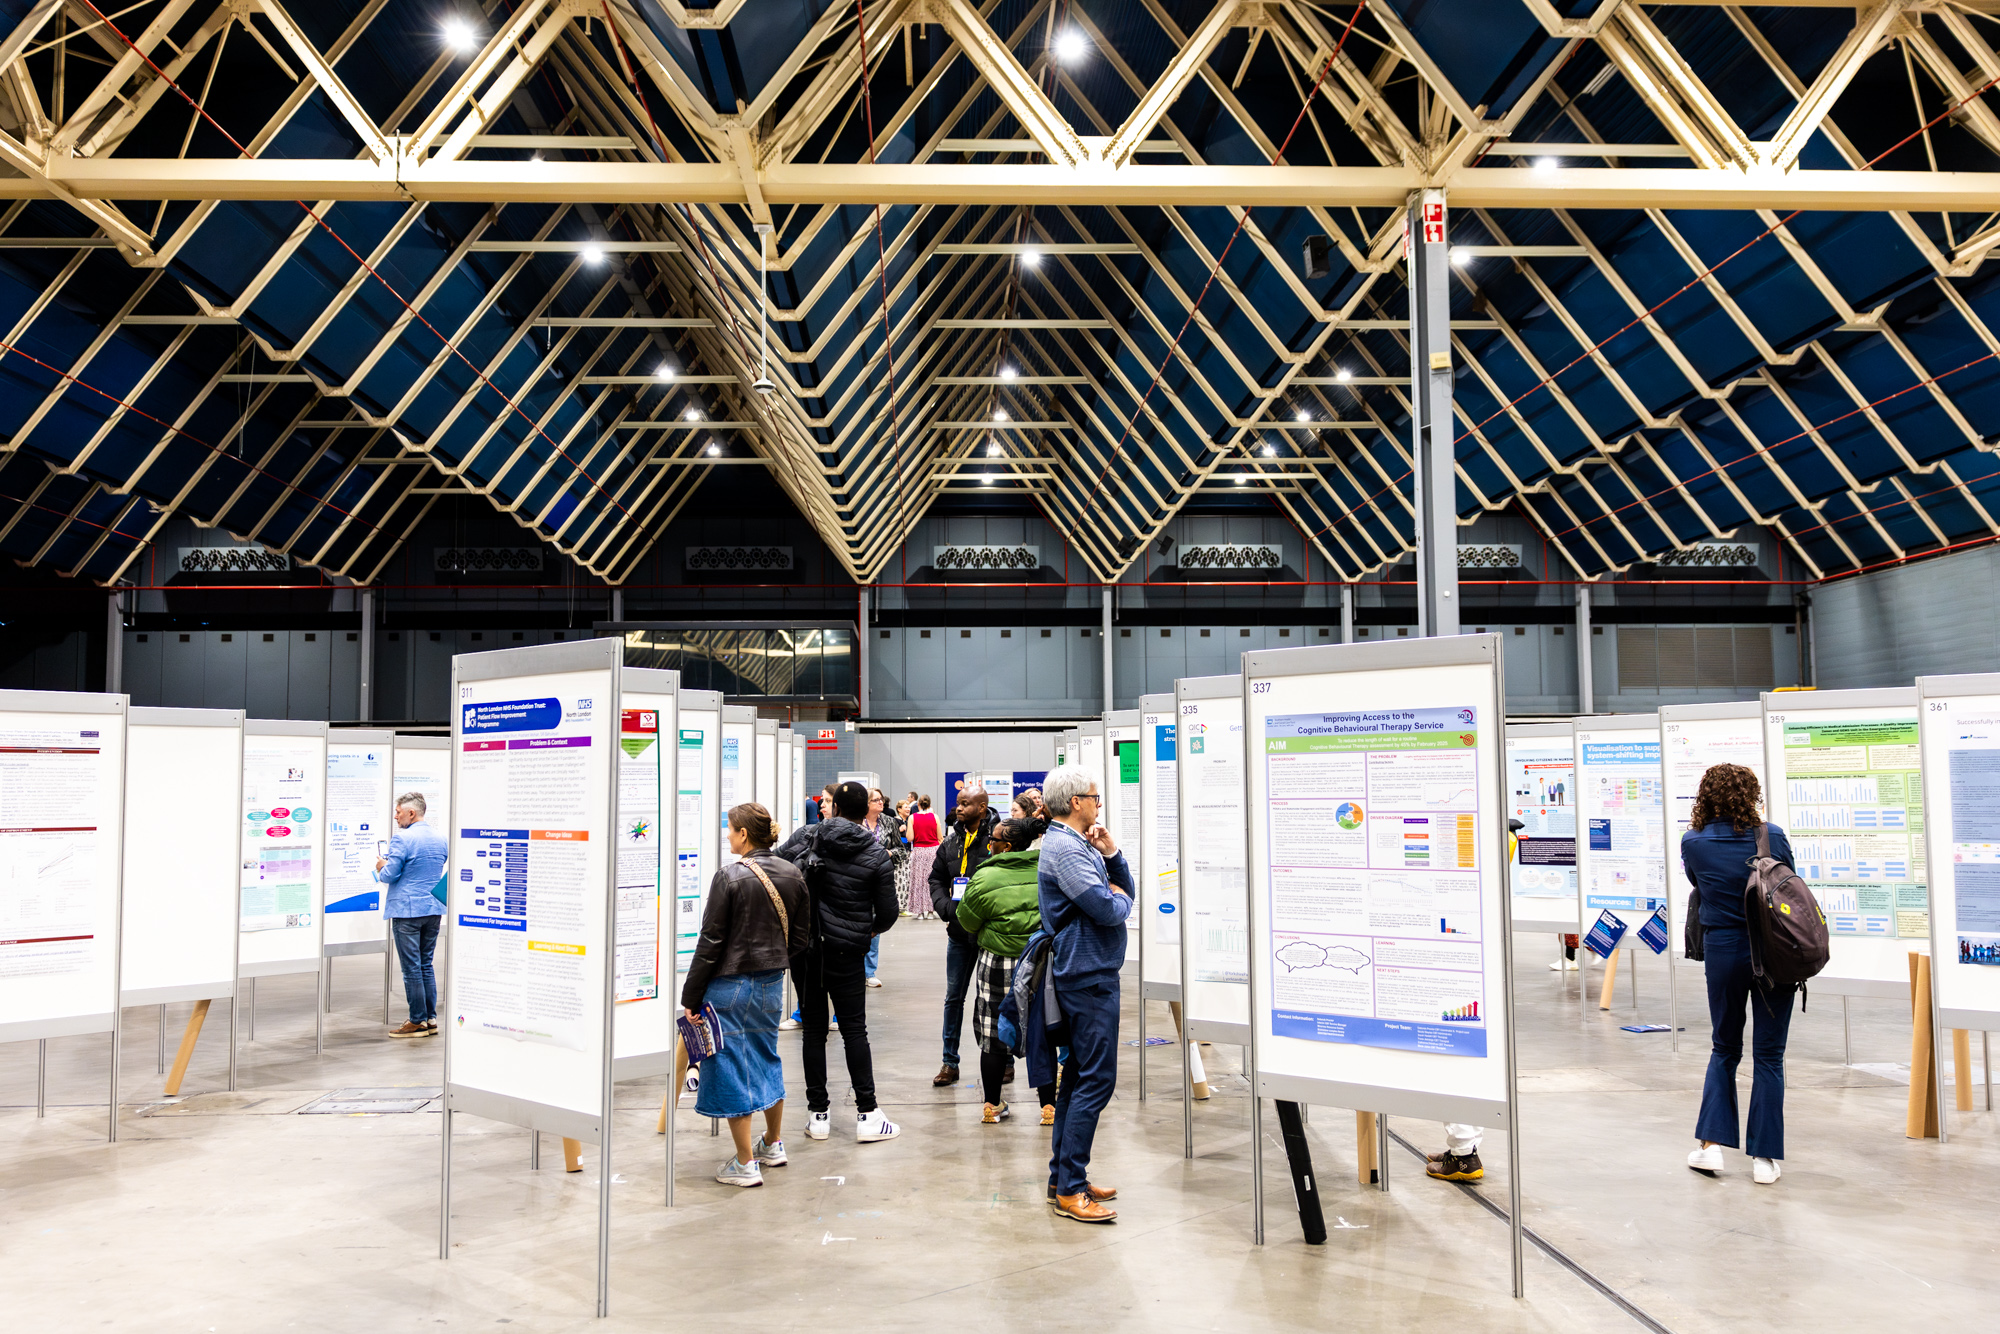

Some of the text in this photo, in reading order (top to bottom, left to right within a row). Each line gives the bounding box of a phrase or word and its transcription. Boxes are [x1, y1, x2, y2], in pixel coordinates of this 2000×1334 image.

[1253, 683, 1271, 693] 337
[462, 688, 472, 698] 311
[578, 700, 591, 708] NHS
[1930, 703, 1947, 711] 361
[1182, 705, 1198, 714] 335
[1323, 715, 1360, 723] Improving
[1362, 713, 1390, 721] Access
[1298, 726, 1332, 735] Cognitive
[1334, 724, 1378, 733] Behavioural
[1268, 741, 1286, 750] AIM
[1590, 897, 1632, 906] Resources:
